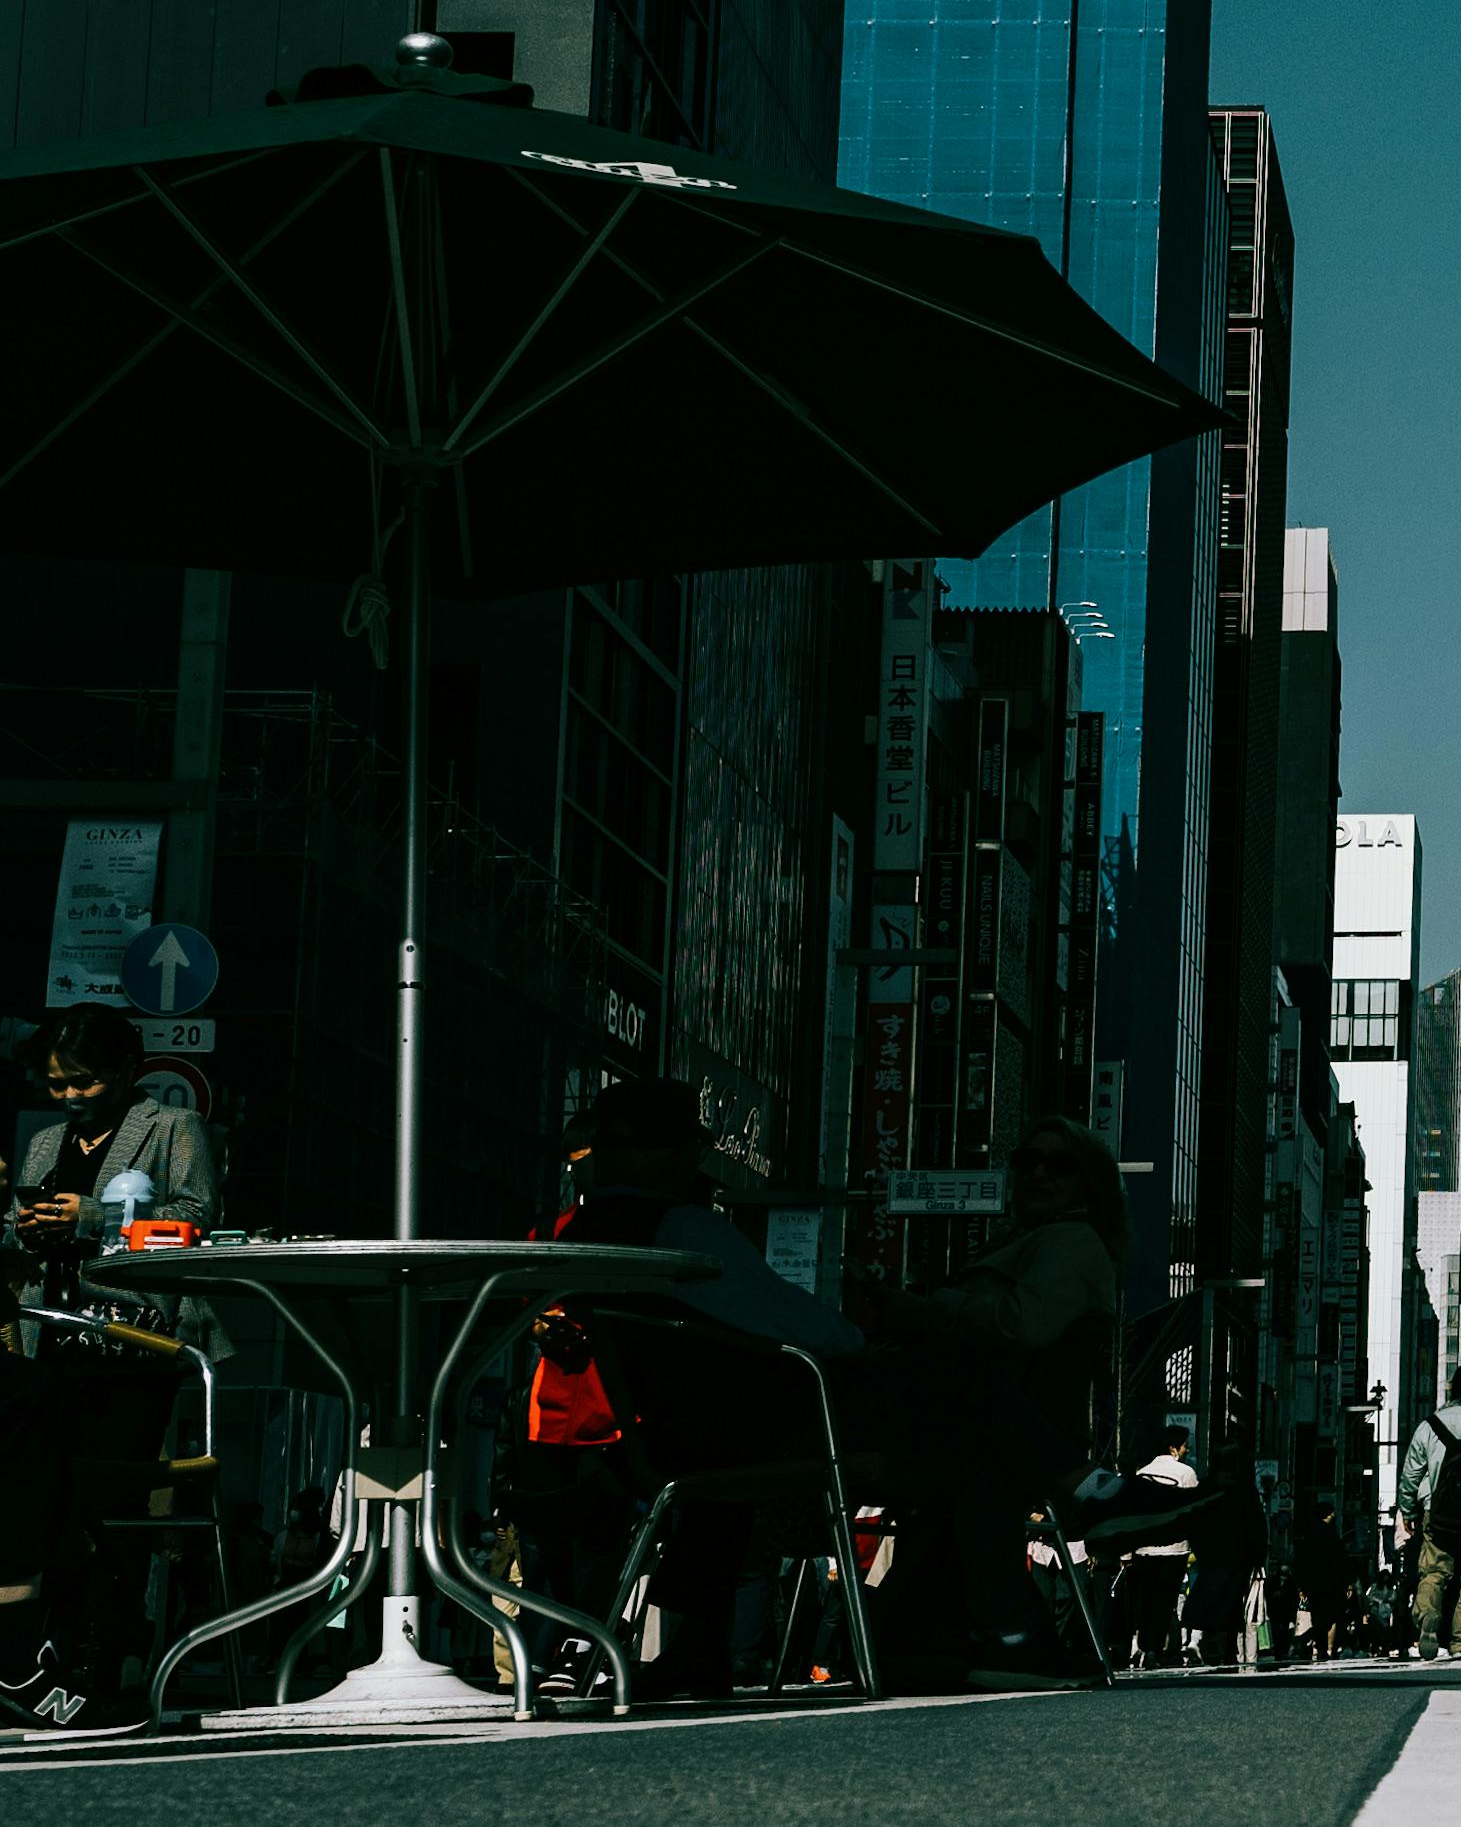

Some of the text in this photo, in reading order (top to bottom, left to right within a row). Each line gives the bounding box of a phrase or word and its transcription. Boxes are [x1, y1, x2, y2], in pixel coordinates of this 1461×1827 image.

[884, 654, 917, 837] 日本香堂ビル
[86, 829, 142, 840] GINZA
[604, 988, 646, 1053] BLOT
[896, 1181, 998, 1200] 銀座三丁目
[925, 1200, 966, 1210] Ginza 3
